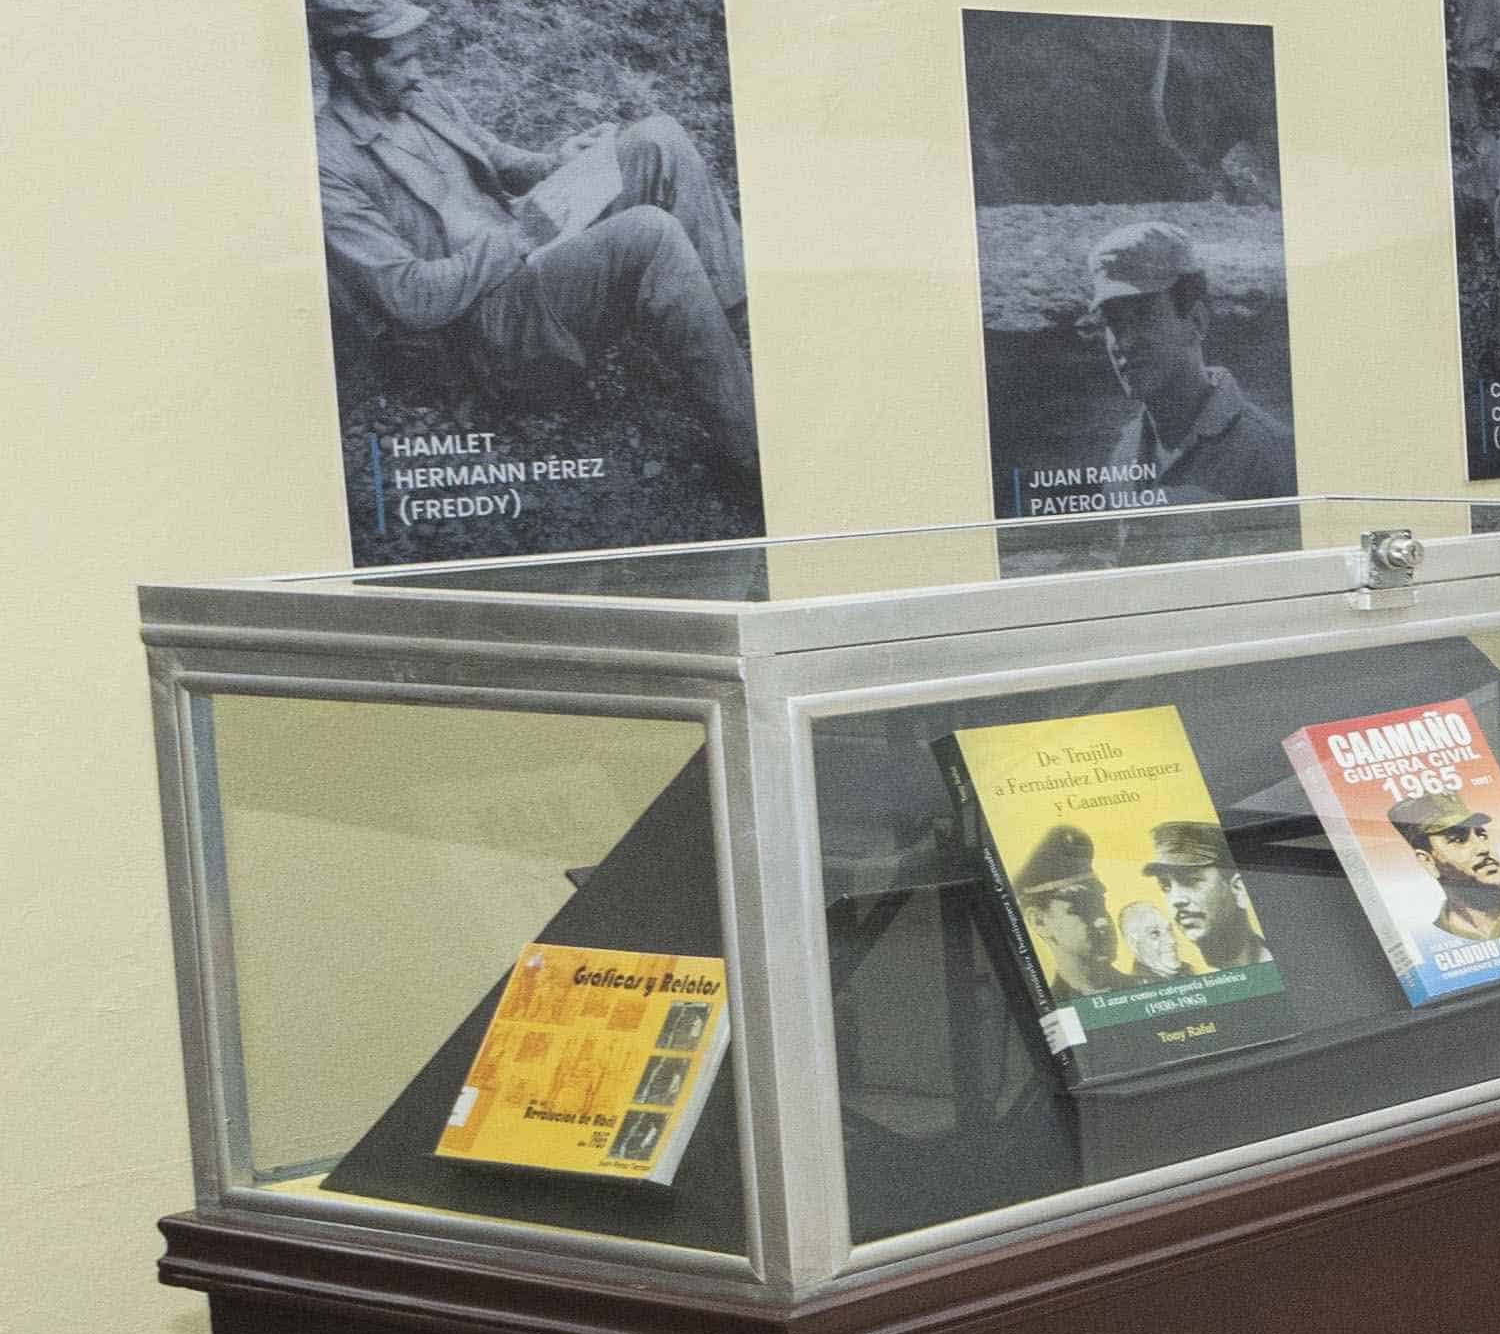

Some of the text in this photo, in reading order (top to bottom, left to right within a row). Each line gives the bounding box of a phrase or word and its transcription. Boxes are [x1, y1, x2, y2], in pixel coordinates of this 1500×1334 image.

[391, 432, 496, 458] HAMLET
[394, 455, 605, 490] HERMANN PÉREZ
[1029, 459, 1156, 488] JUAN RAMÓN
[400, 488, 521, 526] (FREDDY)
[1031, 488, 1168, 516] PAYERO ULLOA
[1036, 741, 1124, 767] De Trujillo
[1327, 711, 1472, 768] CAAMAÑO
[994, 762, 1181, 797] a Fernández Domínguez
[1343, 746, 1481, 784] GUERRA CIVIL
[1382, 766, 1463, 802] 1965
[1054, 789, 1140, 817] y Caamaño
[1433, 940, 1500, 972] CLAUDIO
[643, 975, 655, 997] y
[658, 972, 720, 996] Relatos
[1092, 996, 1106, 1009] El
